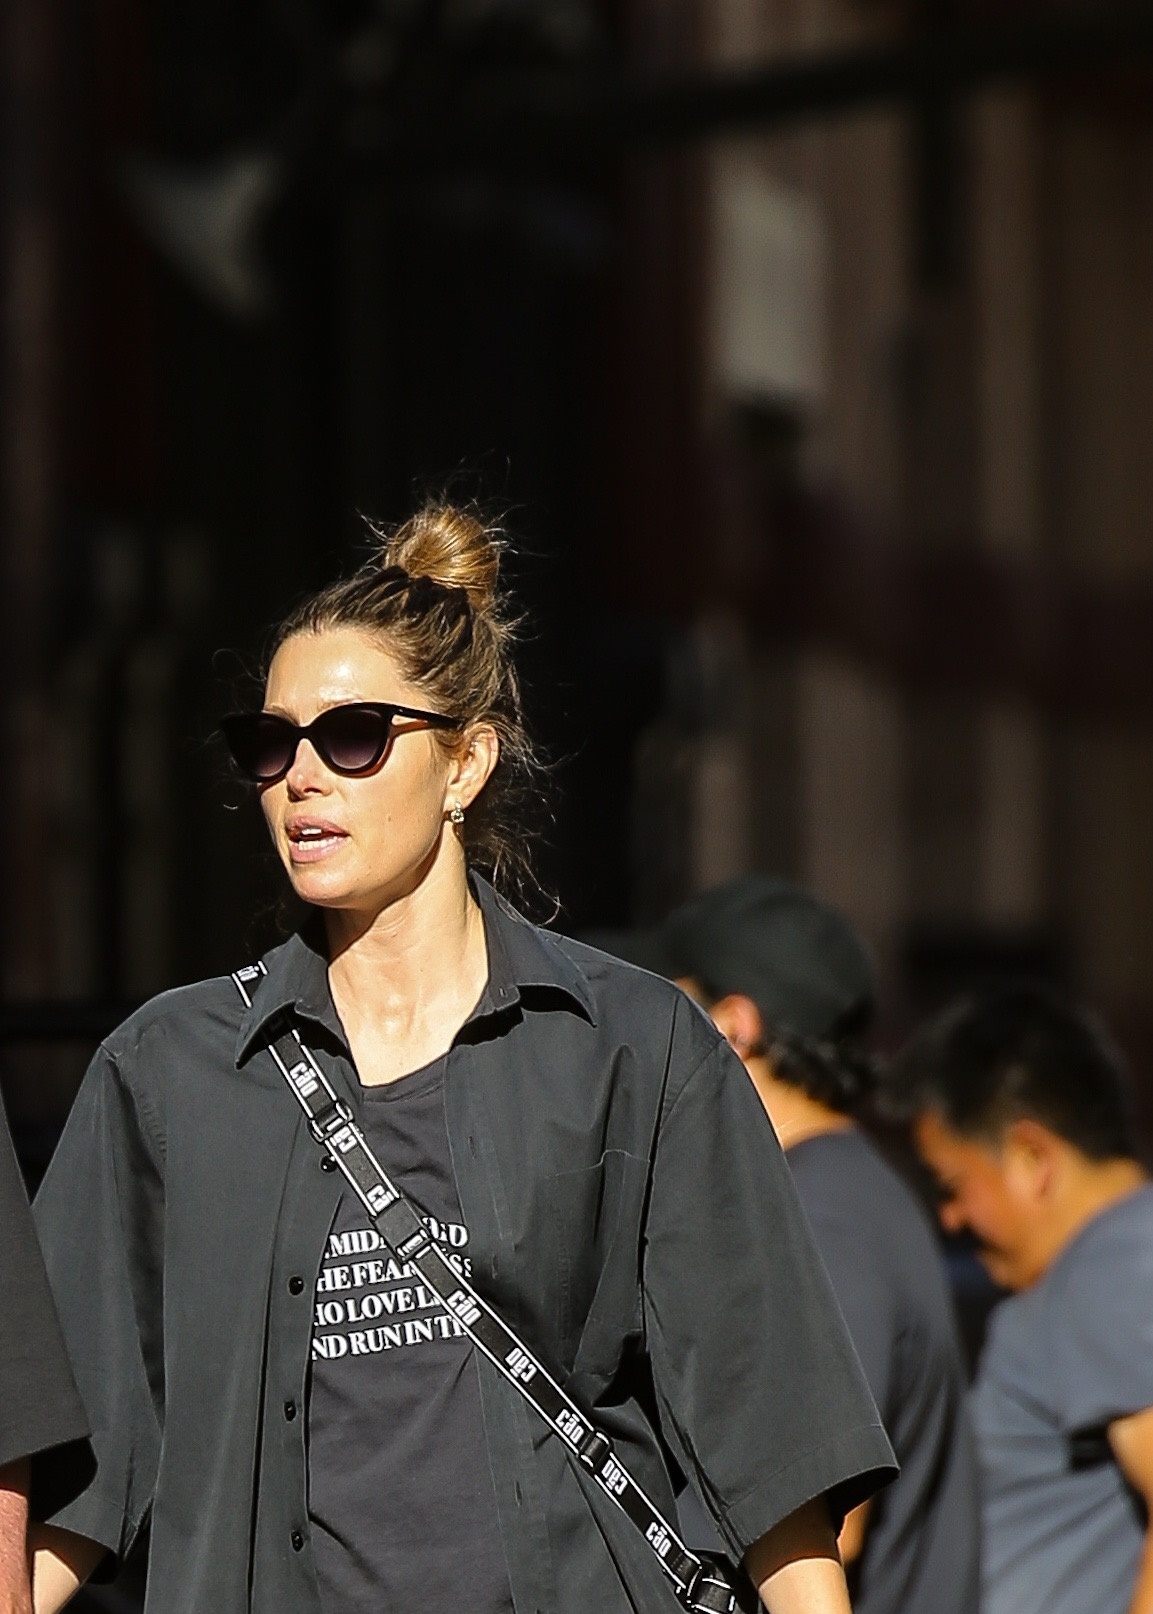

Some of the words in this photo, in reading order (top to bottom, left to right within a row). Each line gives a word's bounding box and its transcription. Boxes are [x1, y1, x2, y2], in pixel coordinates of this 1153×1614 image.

[324, 1229, 387, 1259] MID
[345, 1288, 416, 1322] LOVE
[348, 1323, 403, 1355] RUN
[403, 1318, 434, 1346] IN
